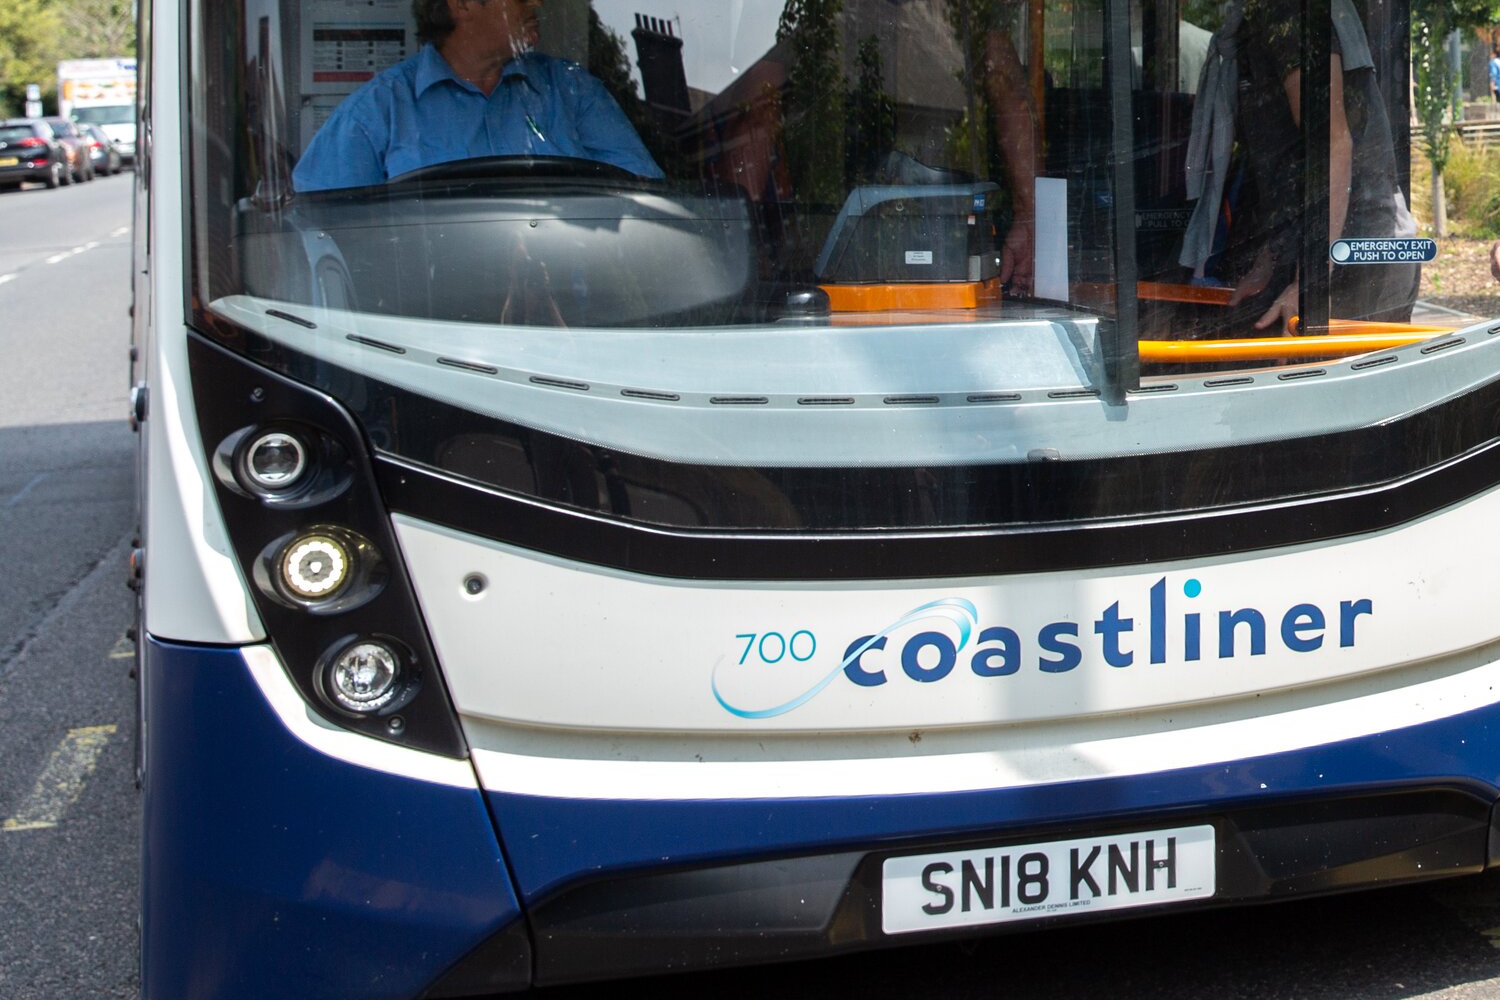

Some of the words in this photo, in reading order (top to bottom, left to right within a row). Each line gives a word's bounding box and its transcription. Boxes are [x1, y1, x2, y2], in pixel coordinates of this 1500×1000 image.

[1350, 240, 1409, 251] EMERGENCY
[1411, 240, 1432, 250] EXIT
[1353, 251, 1380, 261] PUSH
[1381, 251, 1396, 261] TO
[1398, 250, 1425, 261] OPEN
[735, 628, 817, 666] 700
[842, 576, 1373, 687] coastliner
[920, 851, 1050, 917] SN18
[1069, 836, 1178, 901] KNH
[1011, 904, 1046, 914] ALEXANDER
[1046, 902, 1068, 911] DENNIS
[1069, 899, 1091, 908] LIMITED
